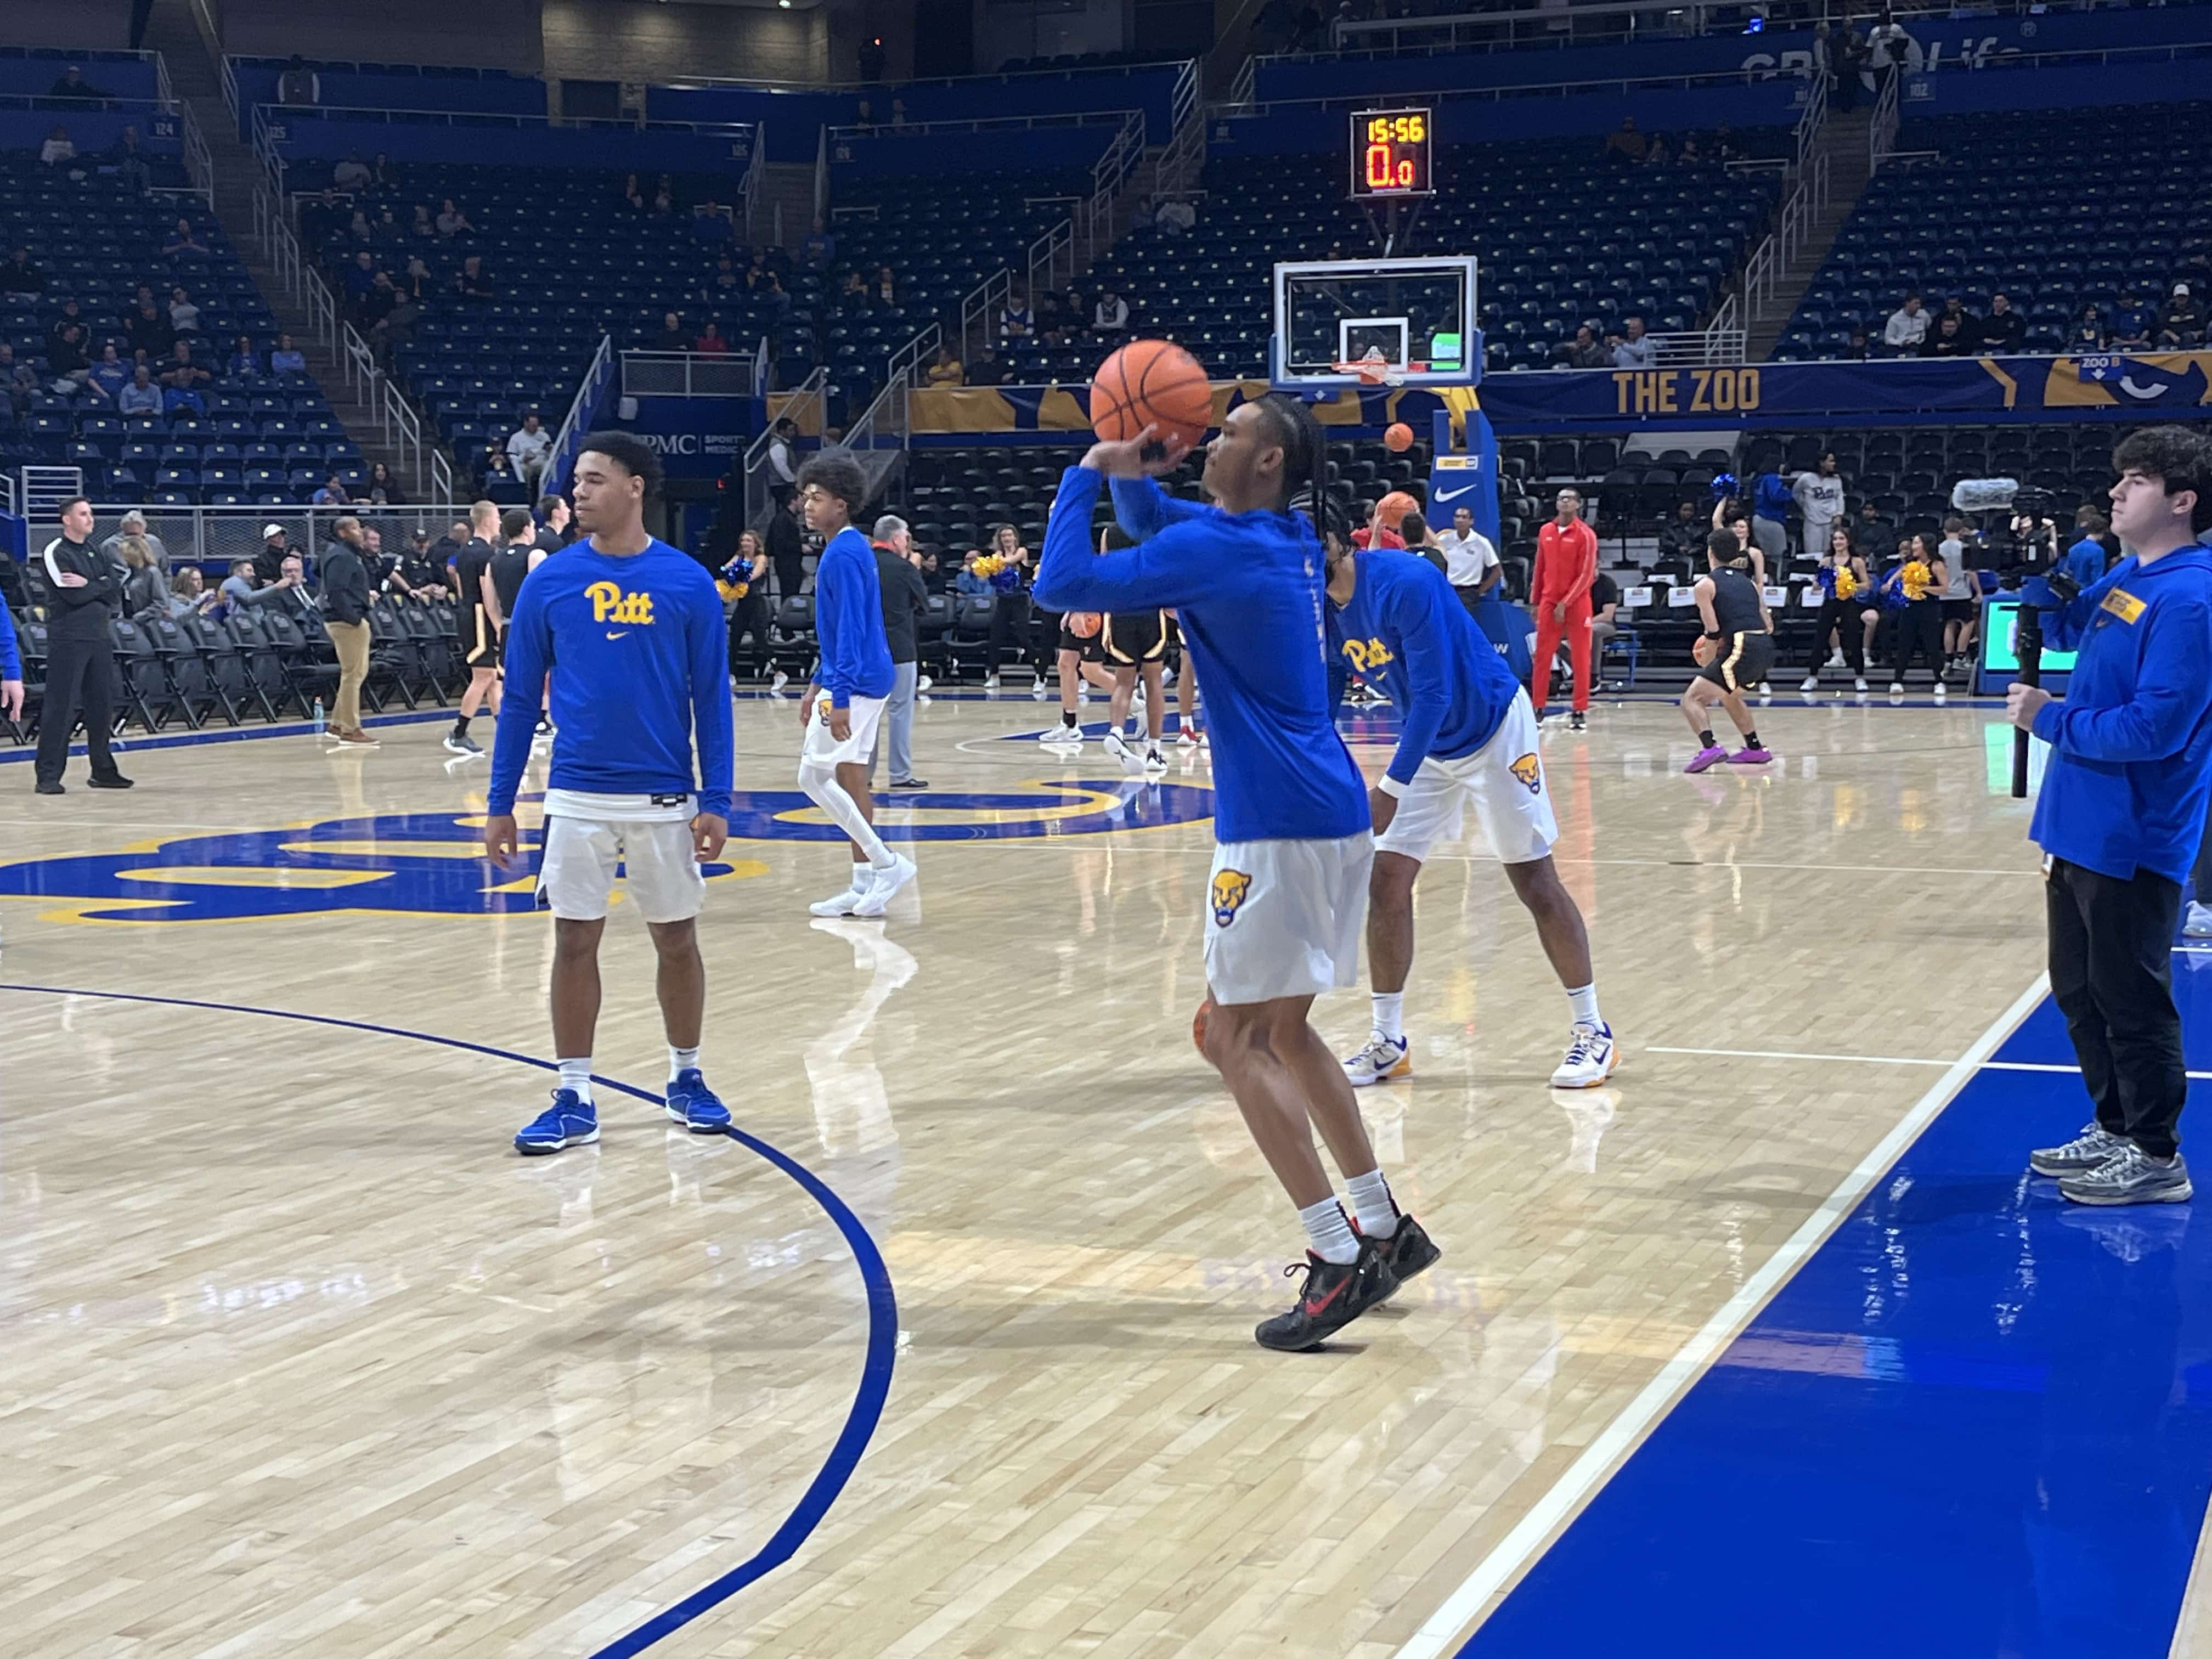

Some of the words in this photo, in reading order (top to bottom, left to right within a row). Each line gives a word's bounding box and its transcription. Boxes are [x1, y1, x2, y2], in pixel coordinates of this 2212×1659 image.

[1368, 116, 1425, 143] 15:56
[2081, 357, 2109, 368] ZOO
[1612, 371, 1678, 413] THE
[1690, 368, 1759, 411] ZOO
[642, 434, 696, 455] PMC
[584, 580, 655, 625] Pitt
[1342, 637, 1394, 673] Pitt
